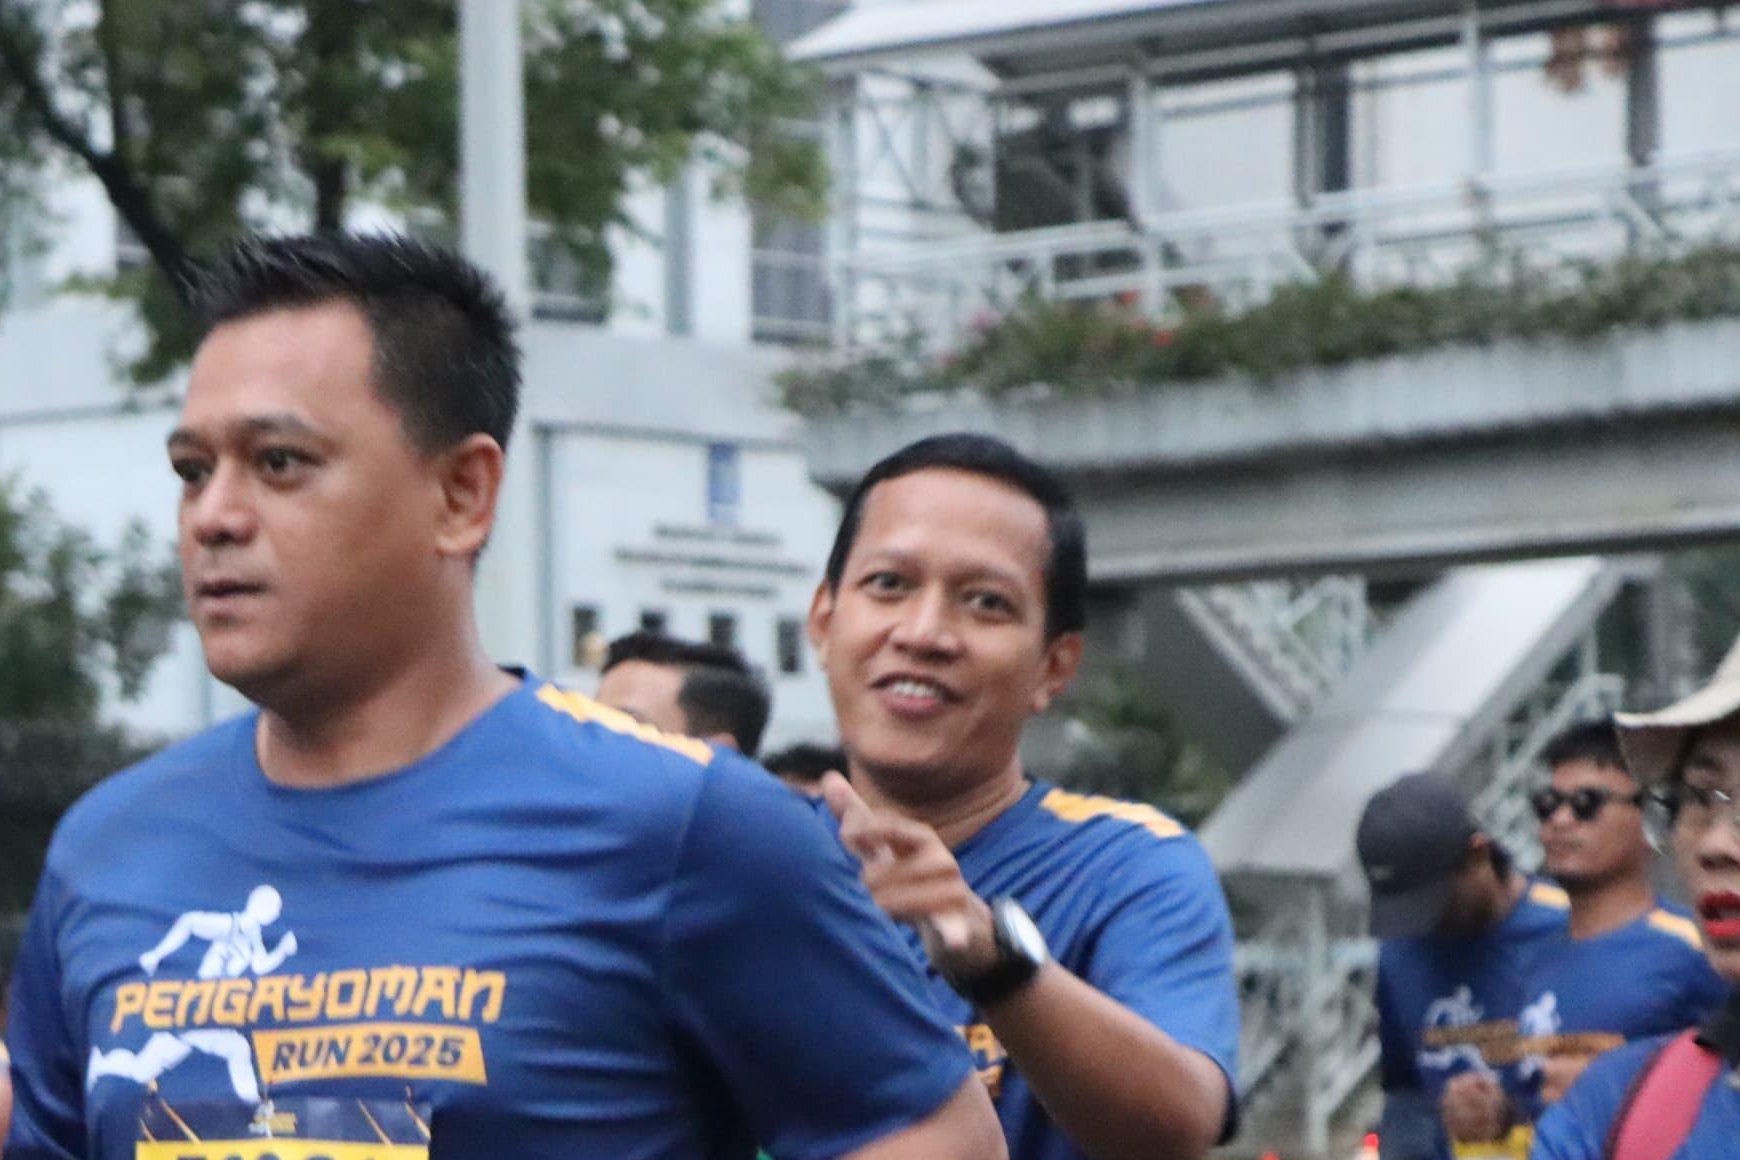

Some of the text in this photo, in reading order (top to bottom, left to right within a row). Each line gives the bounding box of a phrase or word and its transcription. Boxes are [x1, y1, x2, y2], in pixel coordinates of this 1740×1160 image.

[109, 964, 507, 1034] PENGAYOMAN
[271, 1032, 466, 1072] RUN 2025
